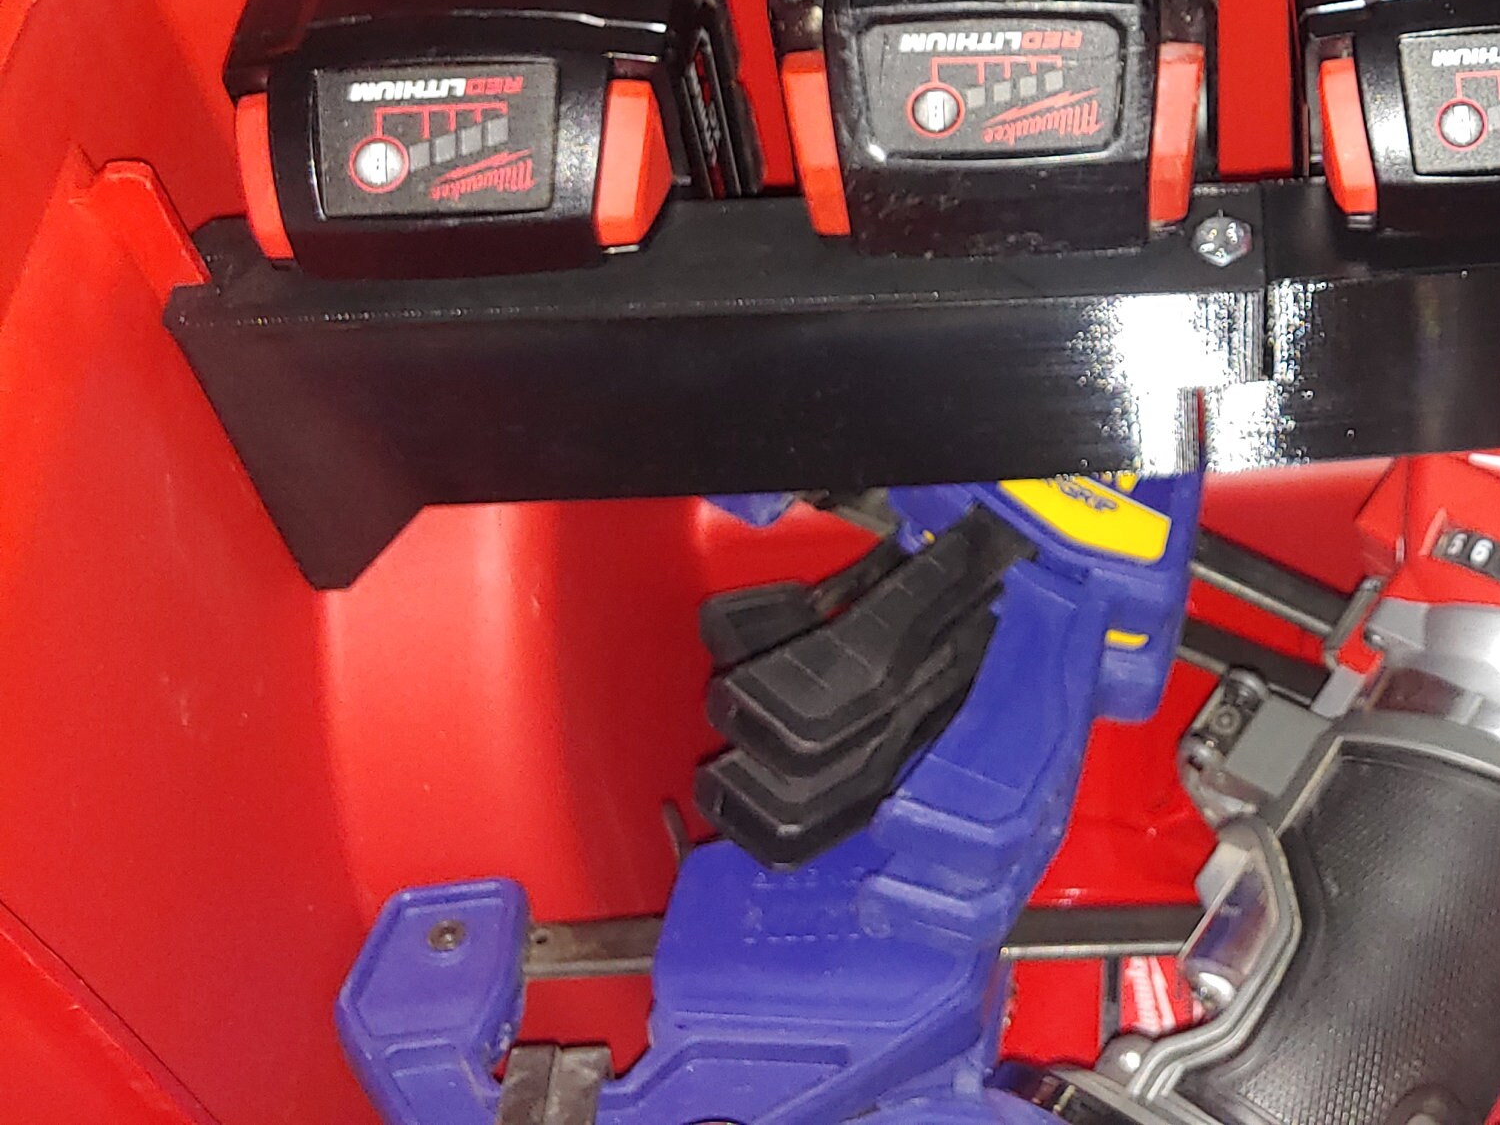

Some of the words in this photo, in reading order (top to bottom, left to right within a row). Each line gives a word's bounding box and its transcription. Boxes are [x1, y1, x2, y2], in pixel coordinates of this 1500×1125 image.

[898, 29, 1084, 53] REDLITHIUM
[346, 75, 524, 103] REDLITHIUM
[980, 99, 1105, 147] Milwaukee
[428, 158, 537, 203] Milwaukee
[1469, 538, 1495, 568] 6
